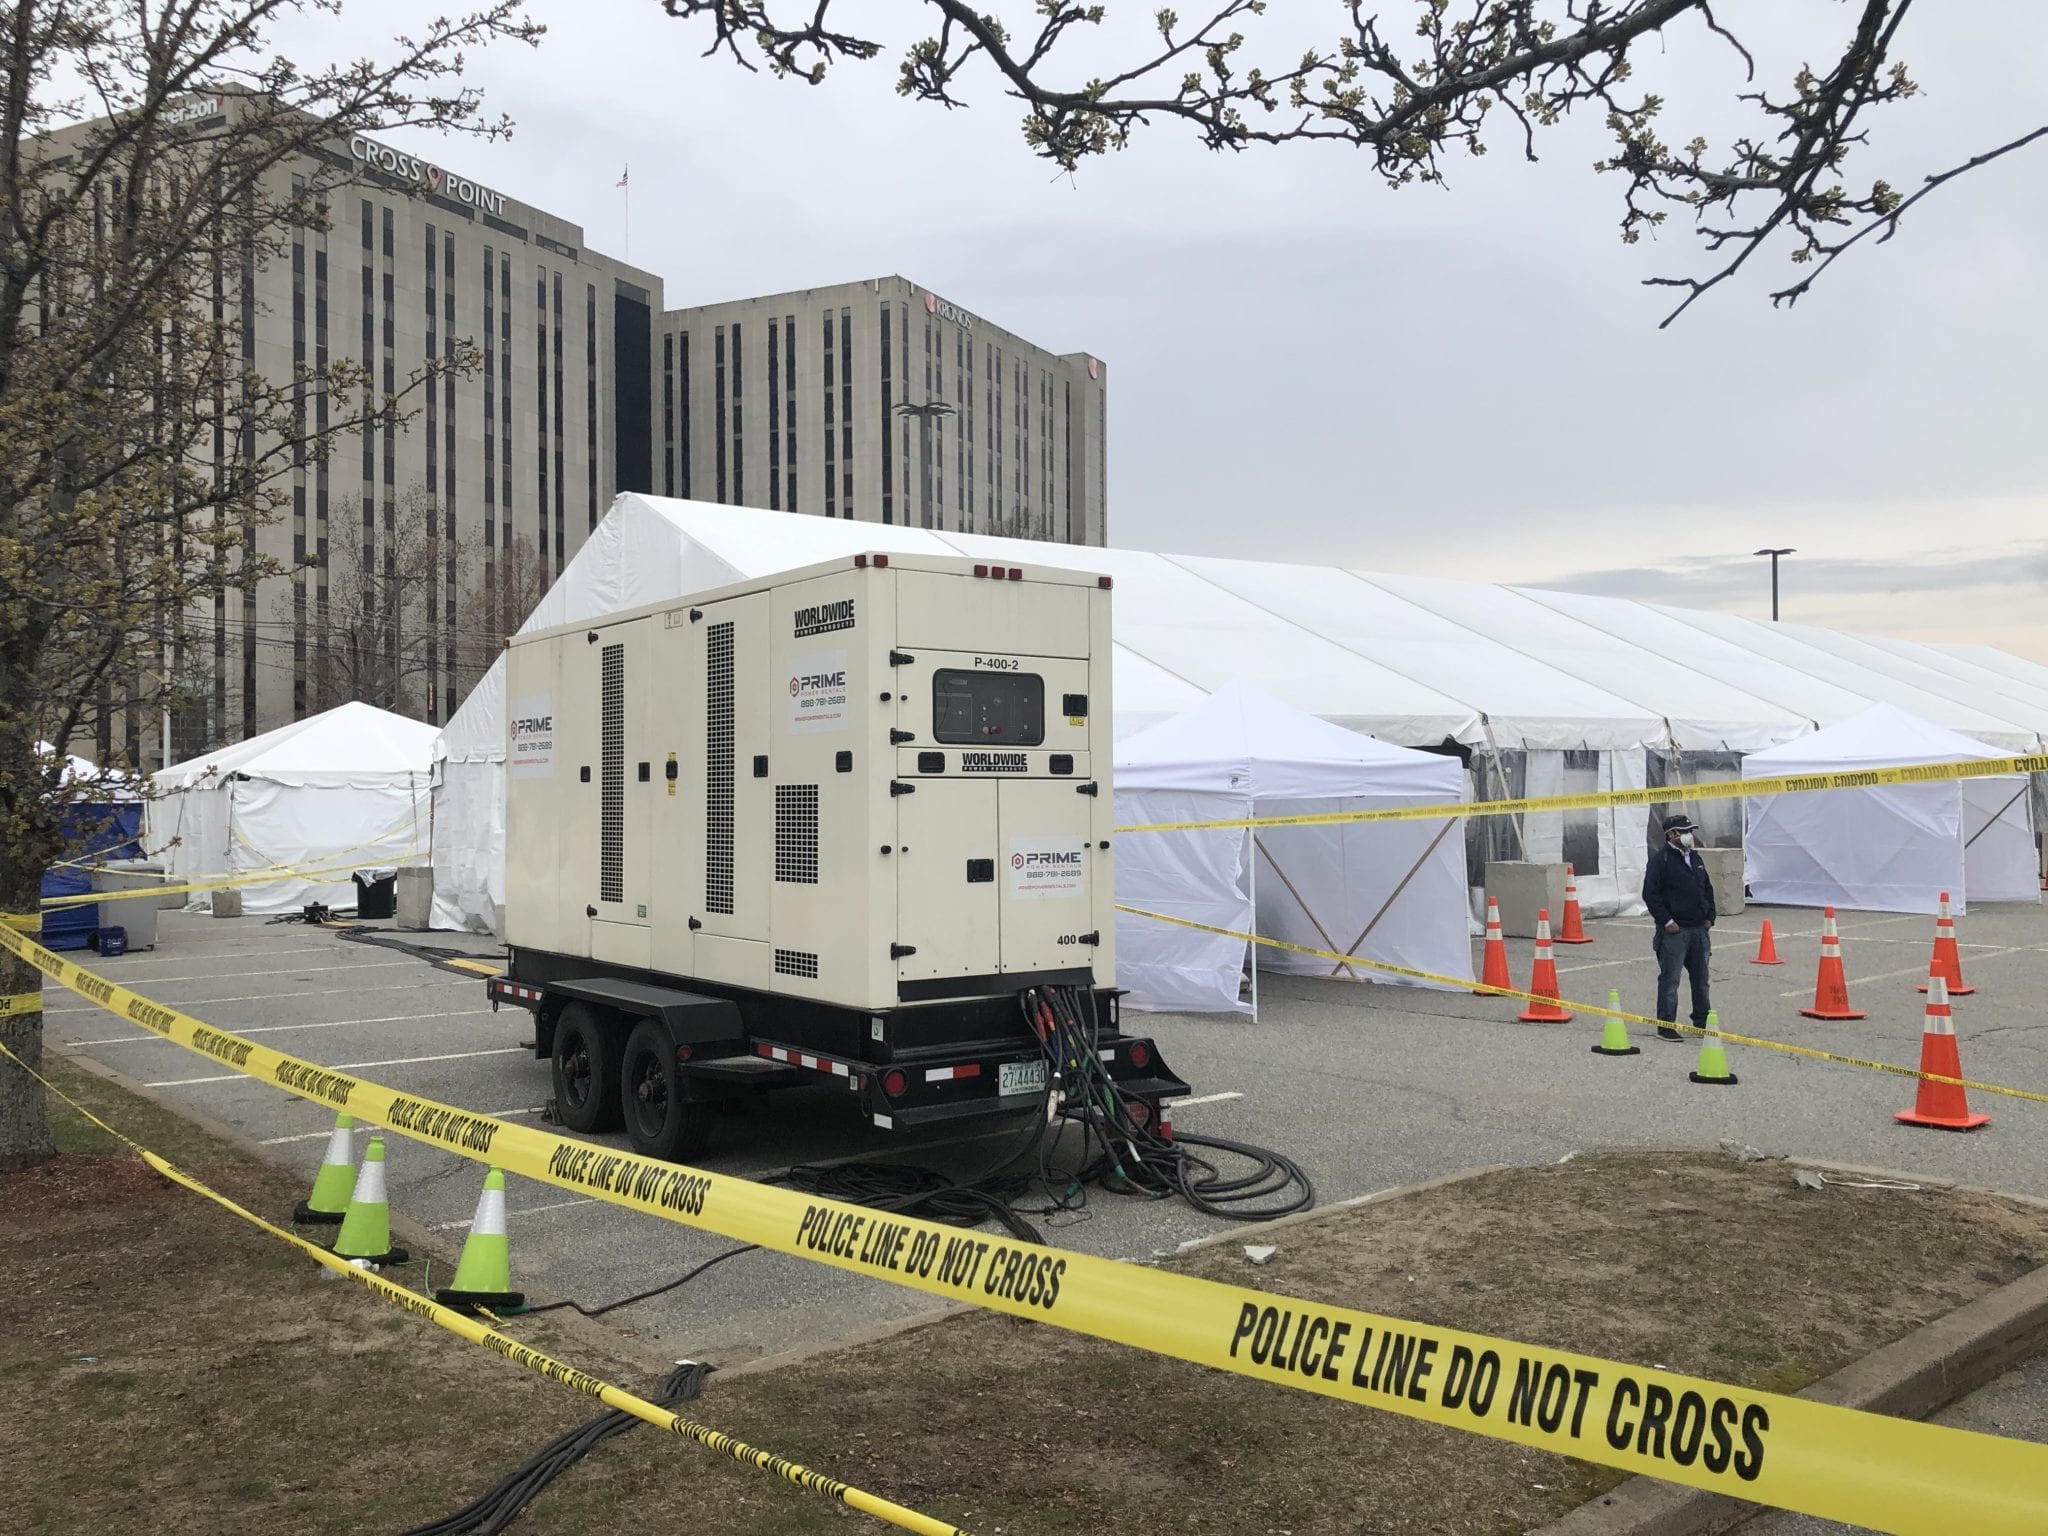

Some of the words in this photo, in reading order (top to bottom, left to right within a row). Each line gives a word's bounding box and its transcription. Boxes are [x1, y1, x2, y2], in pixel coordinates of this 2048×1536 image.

[155, 98, 218, 125] erzon
[350, 136, 421, 181] CROSS
[446, 174, 507, 215] POINT
[935, 300, 972, 330] KRONOS
[794, 599, 855, 629] WORLDWIDE
[974, 657, 1019, 670] P-400-2
[801, 672, 846, 691] PRIME
[518, 716, 553, 734] PRIME
[962, 752, 1028, 766] WORLDWIDE
[1026, 852, 1081, 864] PRIME
[1057, 934, 1077, 946] 400
[387, 1097, 421, 1129] POLICE
[413, 1103, 439, 1135] LINE
[431, 1110, 452, 1139] DO
[443, 1114, 470, 1144] NOT
[462, 1119, 499, 1153] CROSS
[548, 1143, 595, 1183] POLICE
[587, 1153, 622, 1190] LINE
[614, 1160, 640, 1197] DO
[633, 1164, 668, 1203] NOT
[660, 1171, 712, 1216] CROSS
[796, 1205, 865, 1258] POLICE
[859, 1219, 910, 1270] LINE
[904, 1229, 941, 1278] DO
[936, 1236, 989, 1289] NOT
[984, 1246, 1067, 1309] CROSS
[1230, 1302, 1351, 1381] POLICE
[1352, 1327, 1438, 1402] LINE
[1441, 1344, 1500, 1417] DO
[1507, 1356, 1599, 1439] NOT
[1605, 1377, 1770, 1481] CROSS
